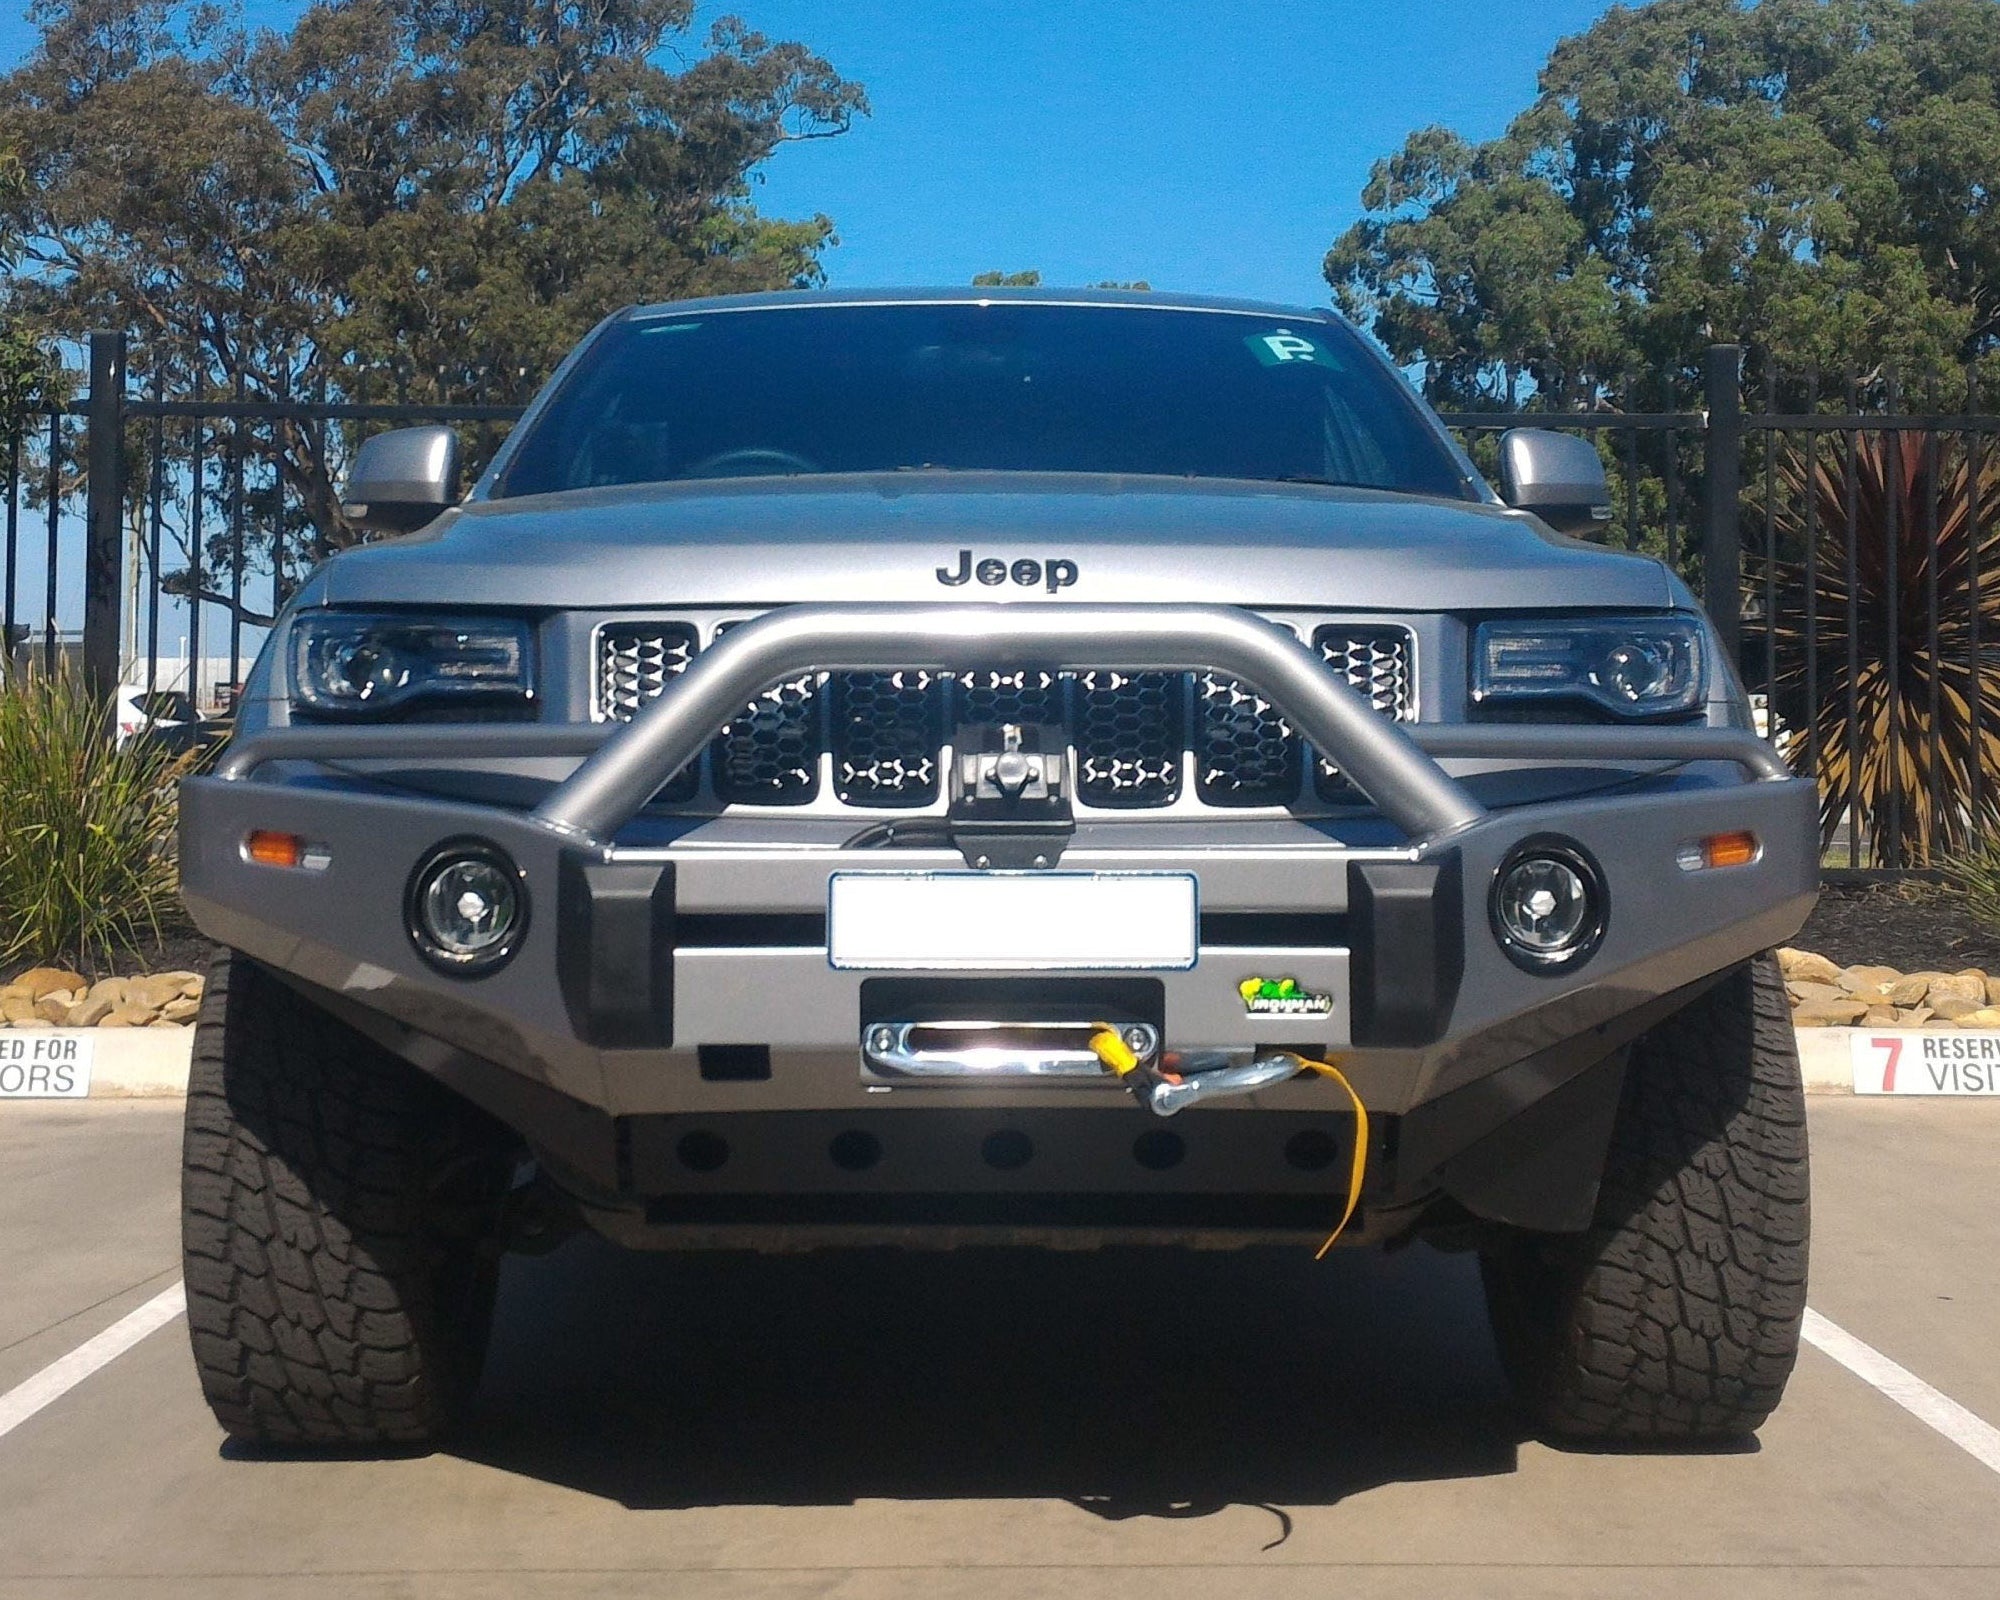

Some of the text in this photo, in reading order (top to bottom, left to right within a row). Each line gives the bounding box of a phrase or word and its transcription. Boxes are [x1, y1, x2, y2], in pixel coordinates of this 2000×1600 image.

[936, 549, 1079, 594] Jeep
[33, 1039, 77, 1060] FOR
[1871, 1038, 1902, 1091] 7
[0, 1064, 75, 1092] ORS
